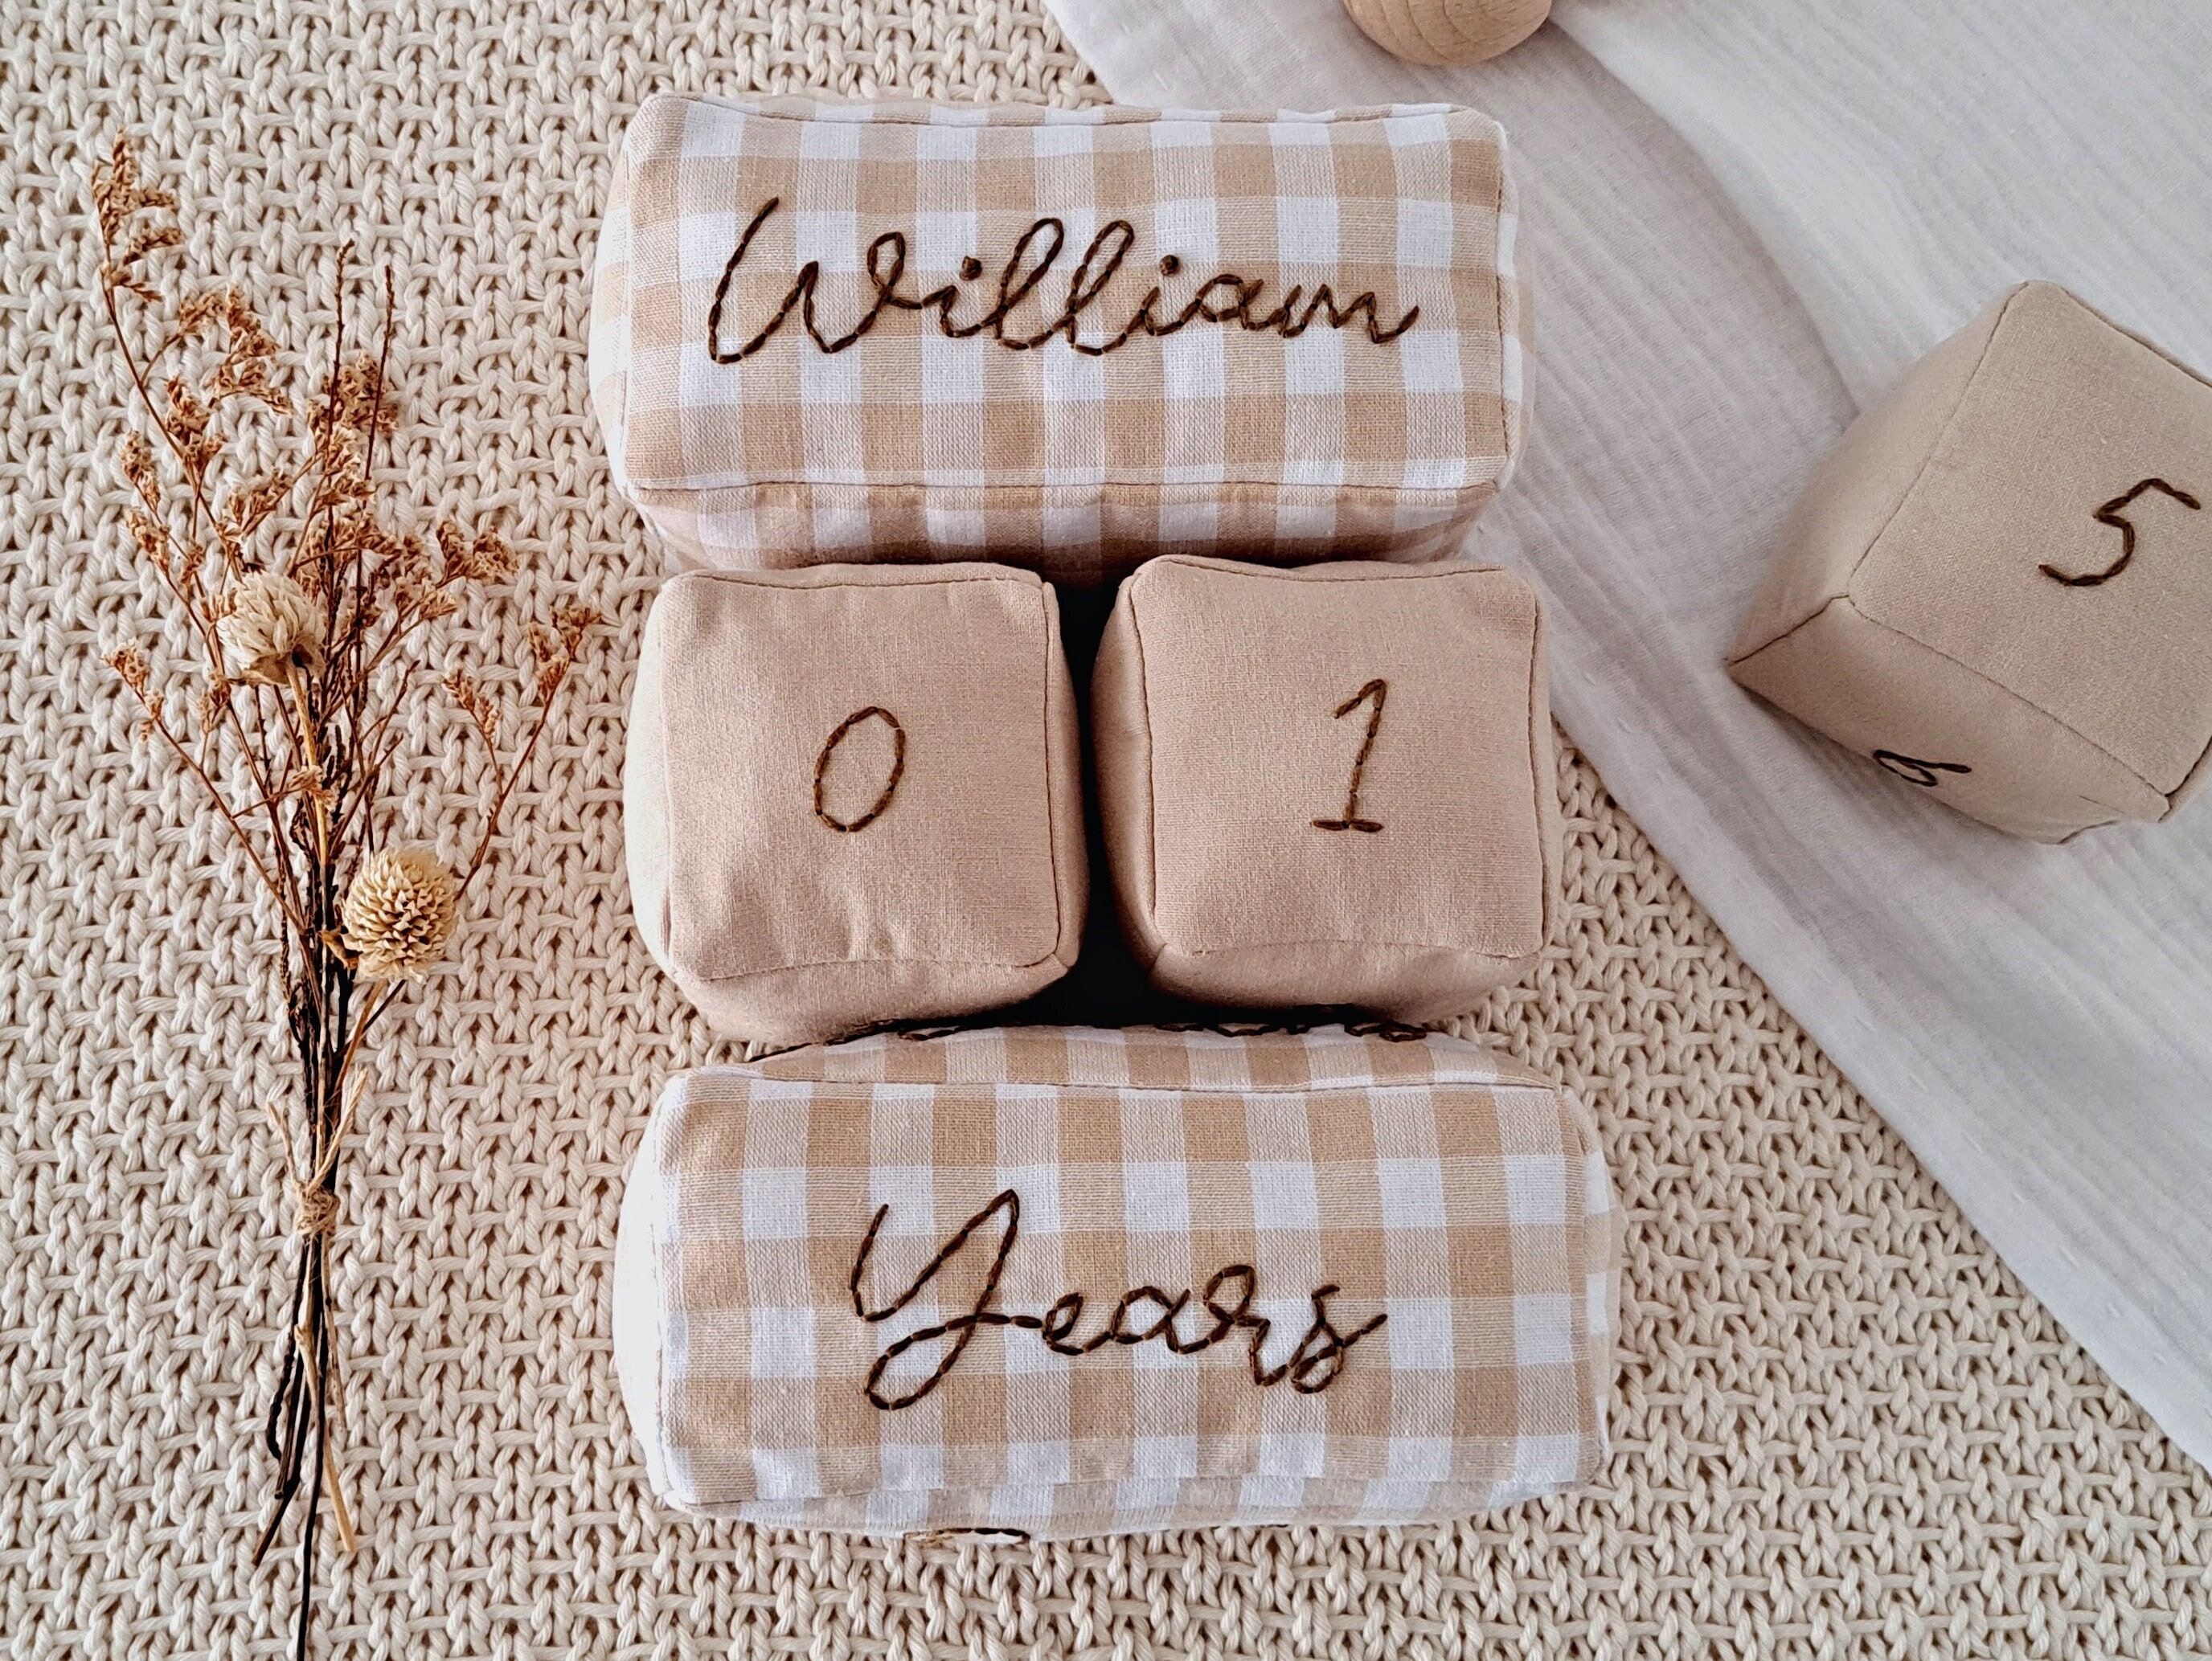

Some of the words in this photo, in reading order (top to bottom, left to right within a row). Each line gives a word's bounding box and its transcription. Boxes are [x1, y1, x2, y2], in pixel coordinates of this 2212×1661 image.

[708, 195, 1421, 365] William
[2037, 477, 2202, 587] 5
[848, 1188, 1389, 1412] Years
